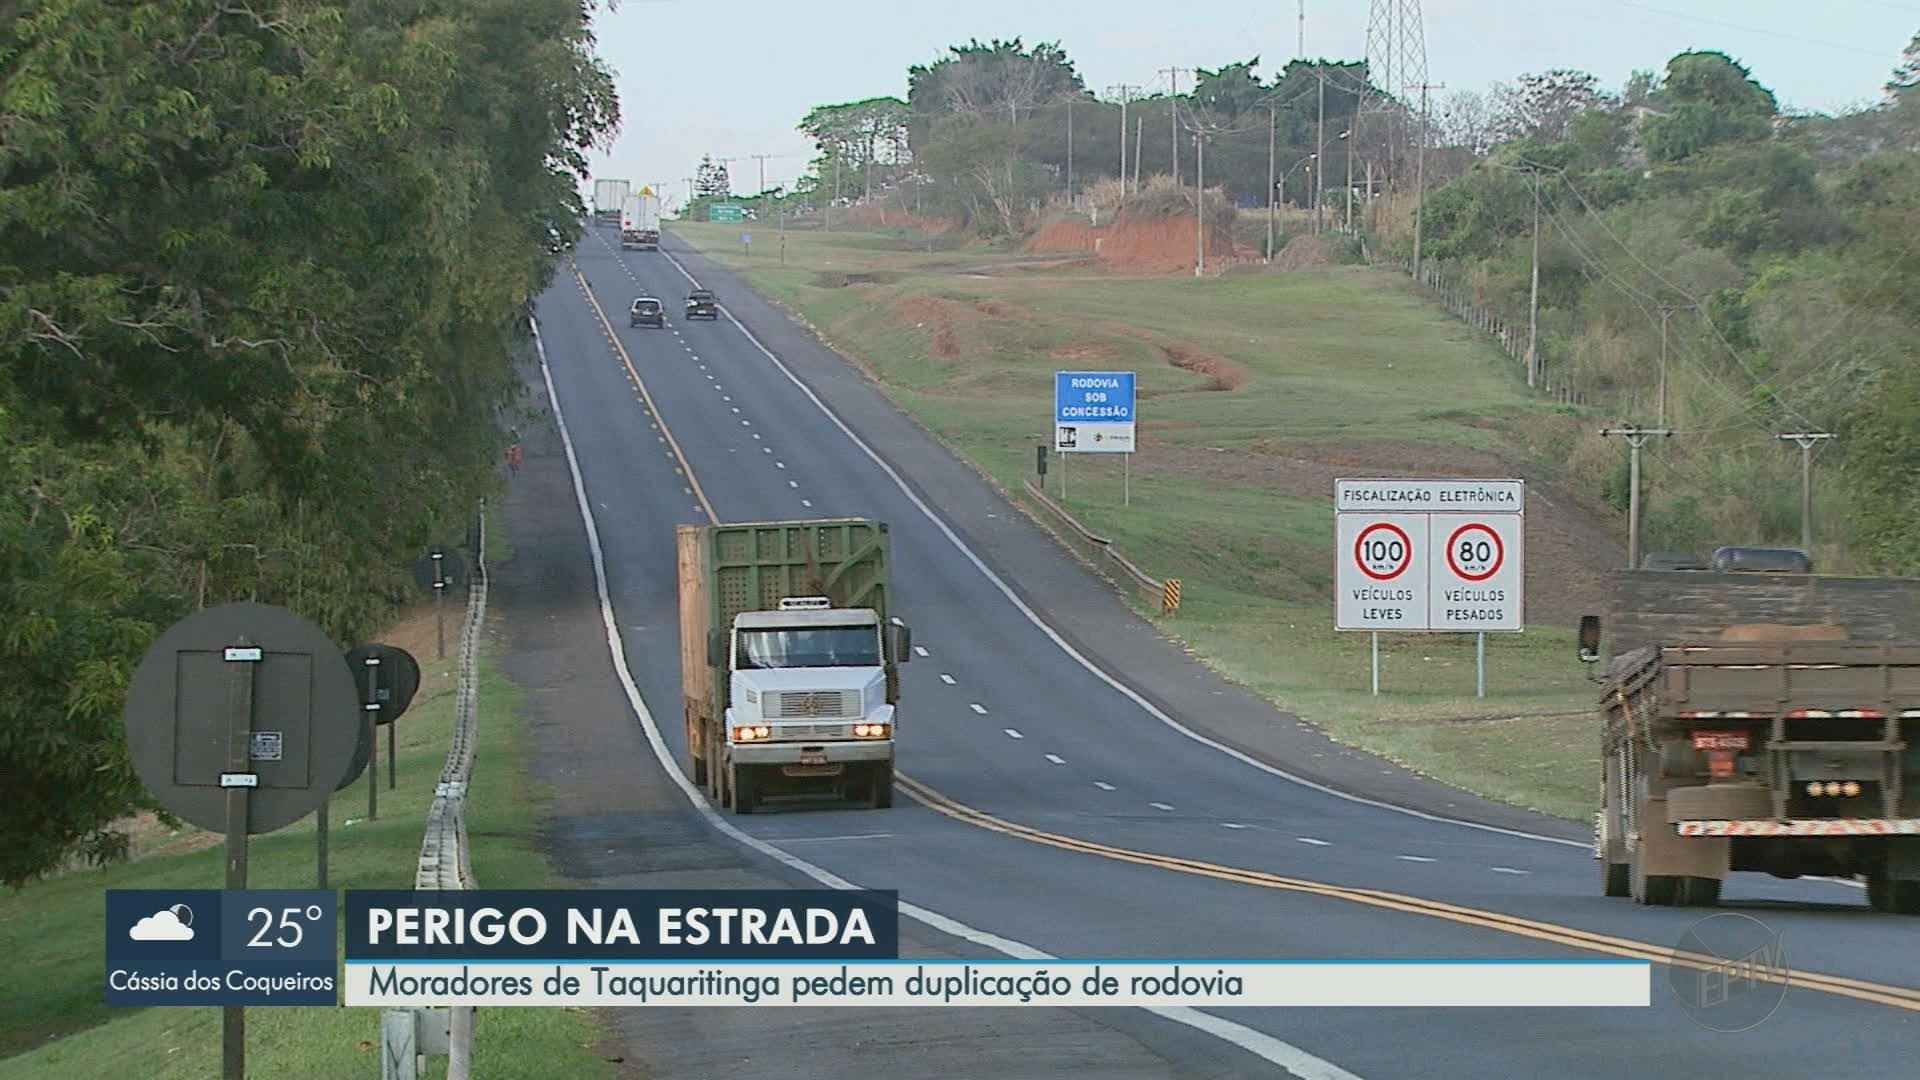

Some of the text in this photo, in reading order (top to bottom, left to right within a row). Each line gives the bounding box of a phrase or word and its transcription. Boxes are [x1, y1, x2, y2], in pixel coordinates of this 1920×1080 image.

[1071, 378, 1119, 389] RODOVIA
[1084, 392, 1107, 402] SOB
[1062, 406, 1128, 417] CONCESSÃO
[1344, 487, 1514, 503] FISCALIZAÇÃO ELETRÔNICA
[1364, 540, 1403, 561] 100
[1459, 541, 1491, 562] 80
[1353, 585, 1413, 600] VEÍCULOS
[1445, 586, 1505, 601] VEÍCULOS
[1363, 608, 1402, 619] LEVES
[1446, 608, 1503, 620] PESADOS
